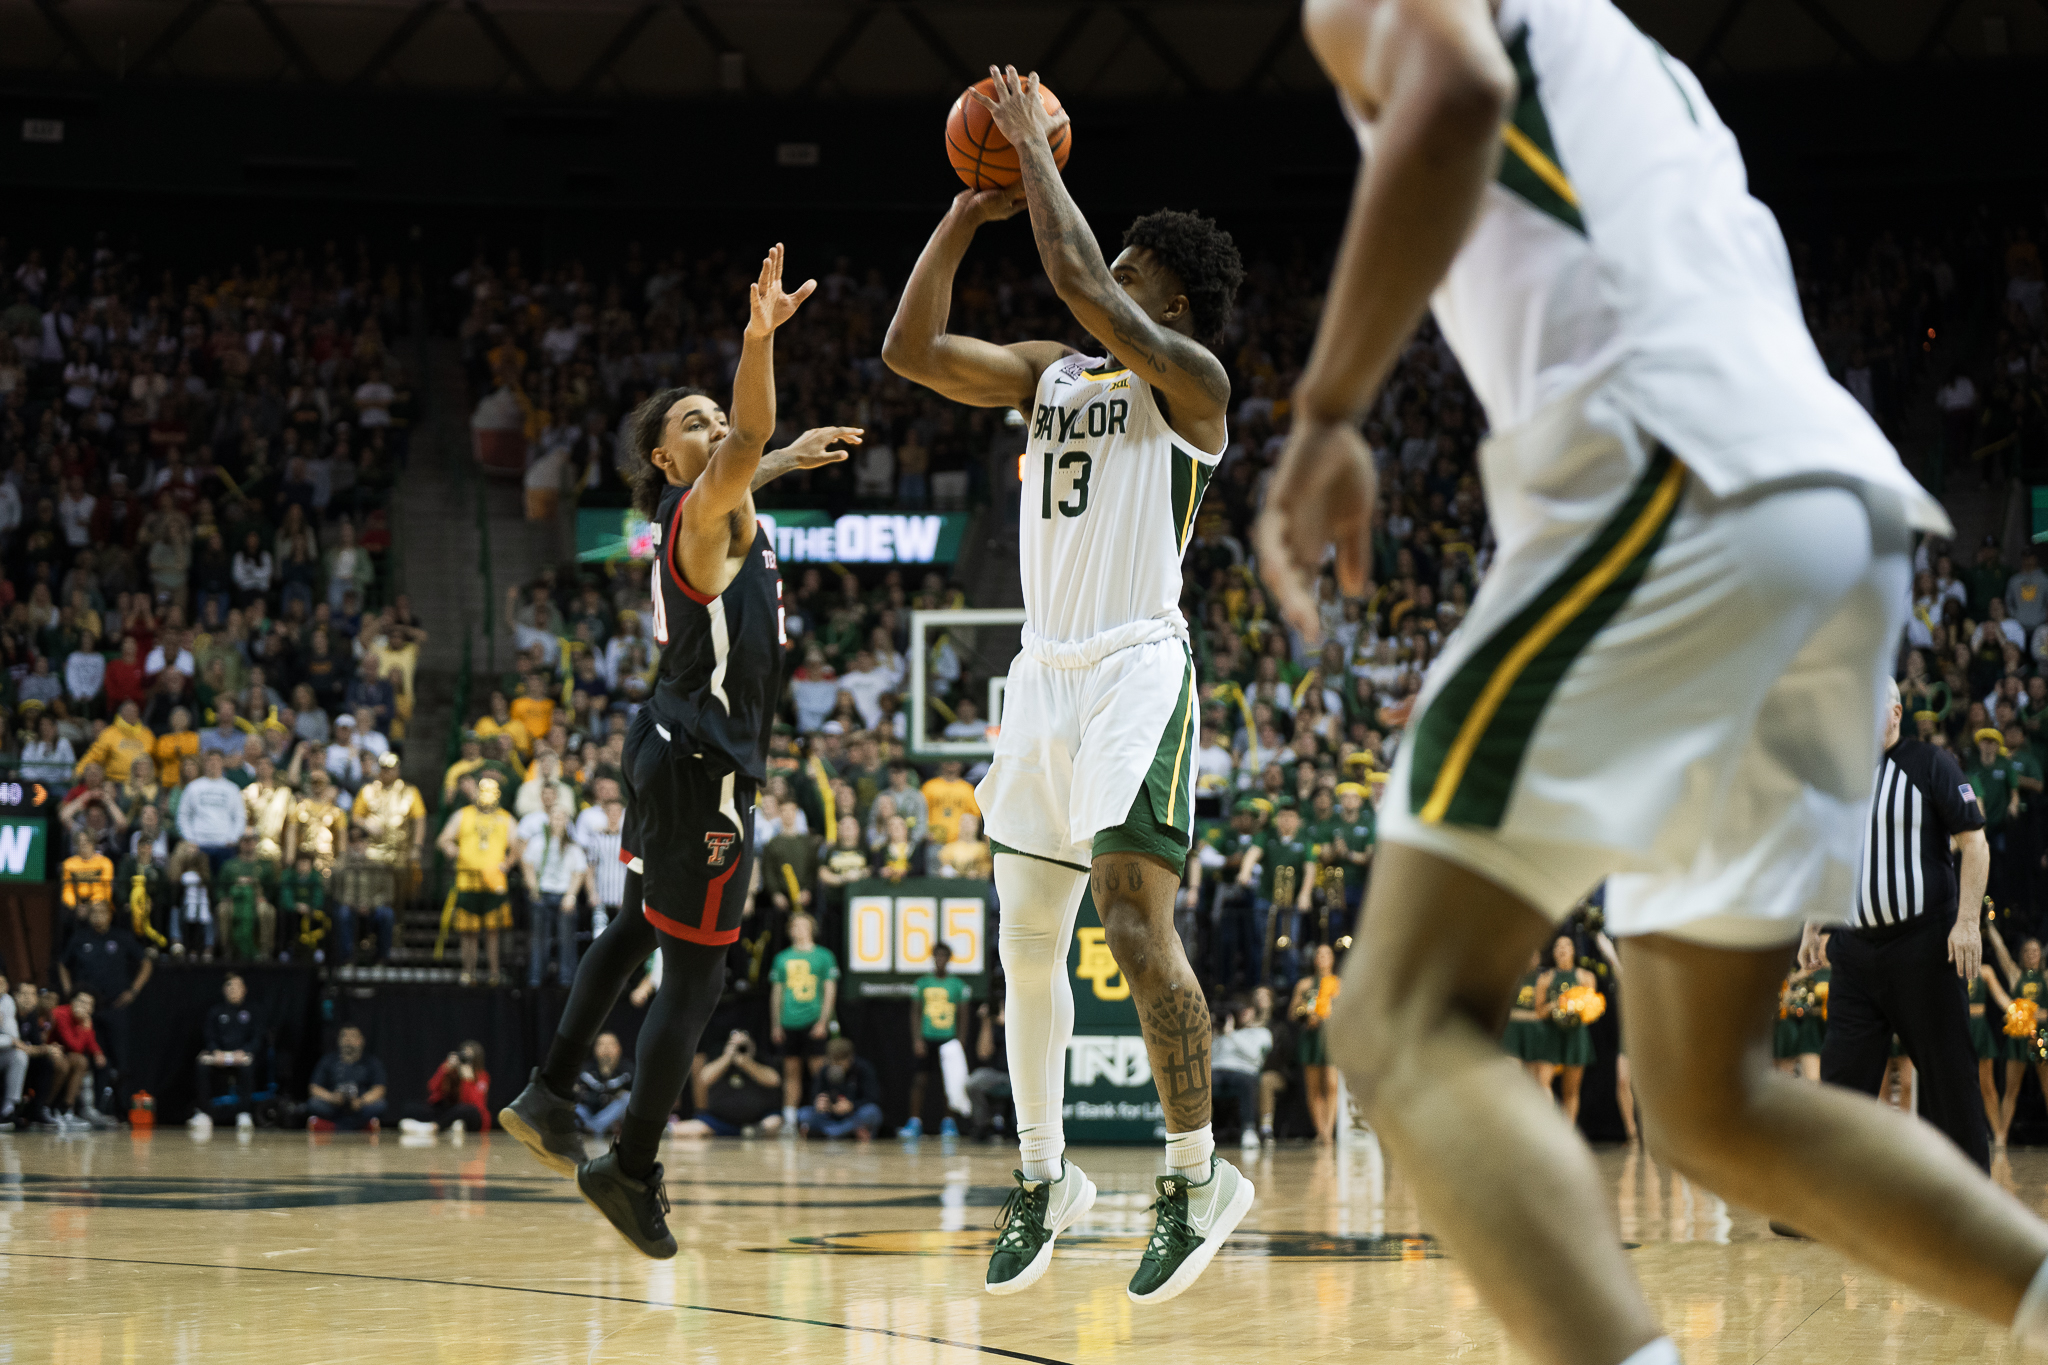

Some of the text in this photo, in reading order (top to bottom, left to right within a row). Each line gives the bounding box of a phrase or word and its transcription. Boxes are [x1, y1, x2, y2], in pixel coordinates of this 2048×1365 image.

[1034, 398, 1128, 443] BAYLOR
[1042, 451, 1093, 519] 13
[776, 526, 835, 562] THE
[857, 906, 977, 964] 065
[1075, 1101, 1117, 1120] Bank
